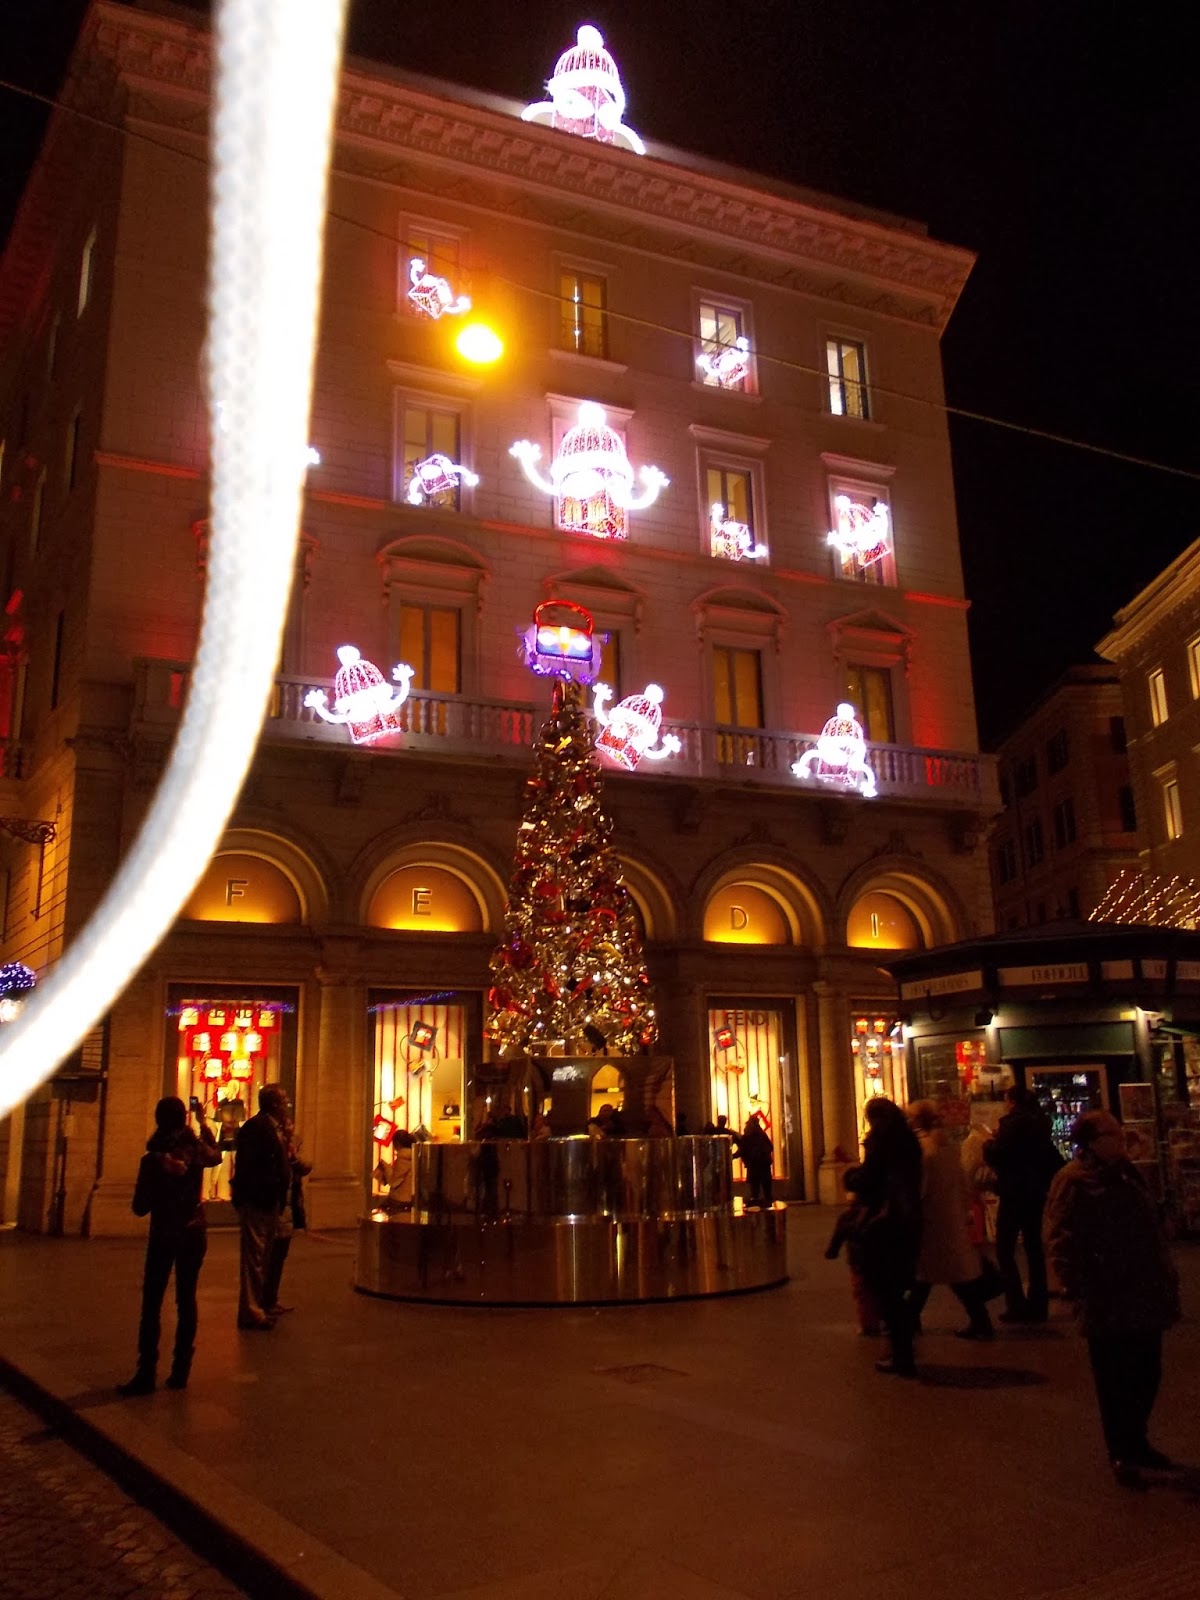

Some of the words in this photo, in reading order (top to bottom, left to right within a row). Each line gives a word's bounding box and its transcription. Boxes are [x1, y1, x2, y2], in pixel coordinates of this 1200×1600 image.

[226, 879, 249, 906] F
[412, 887, 432, 916] E
[730, 905, 749, 930] D
